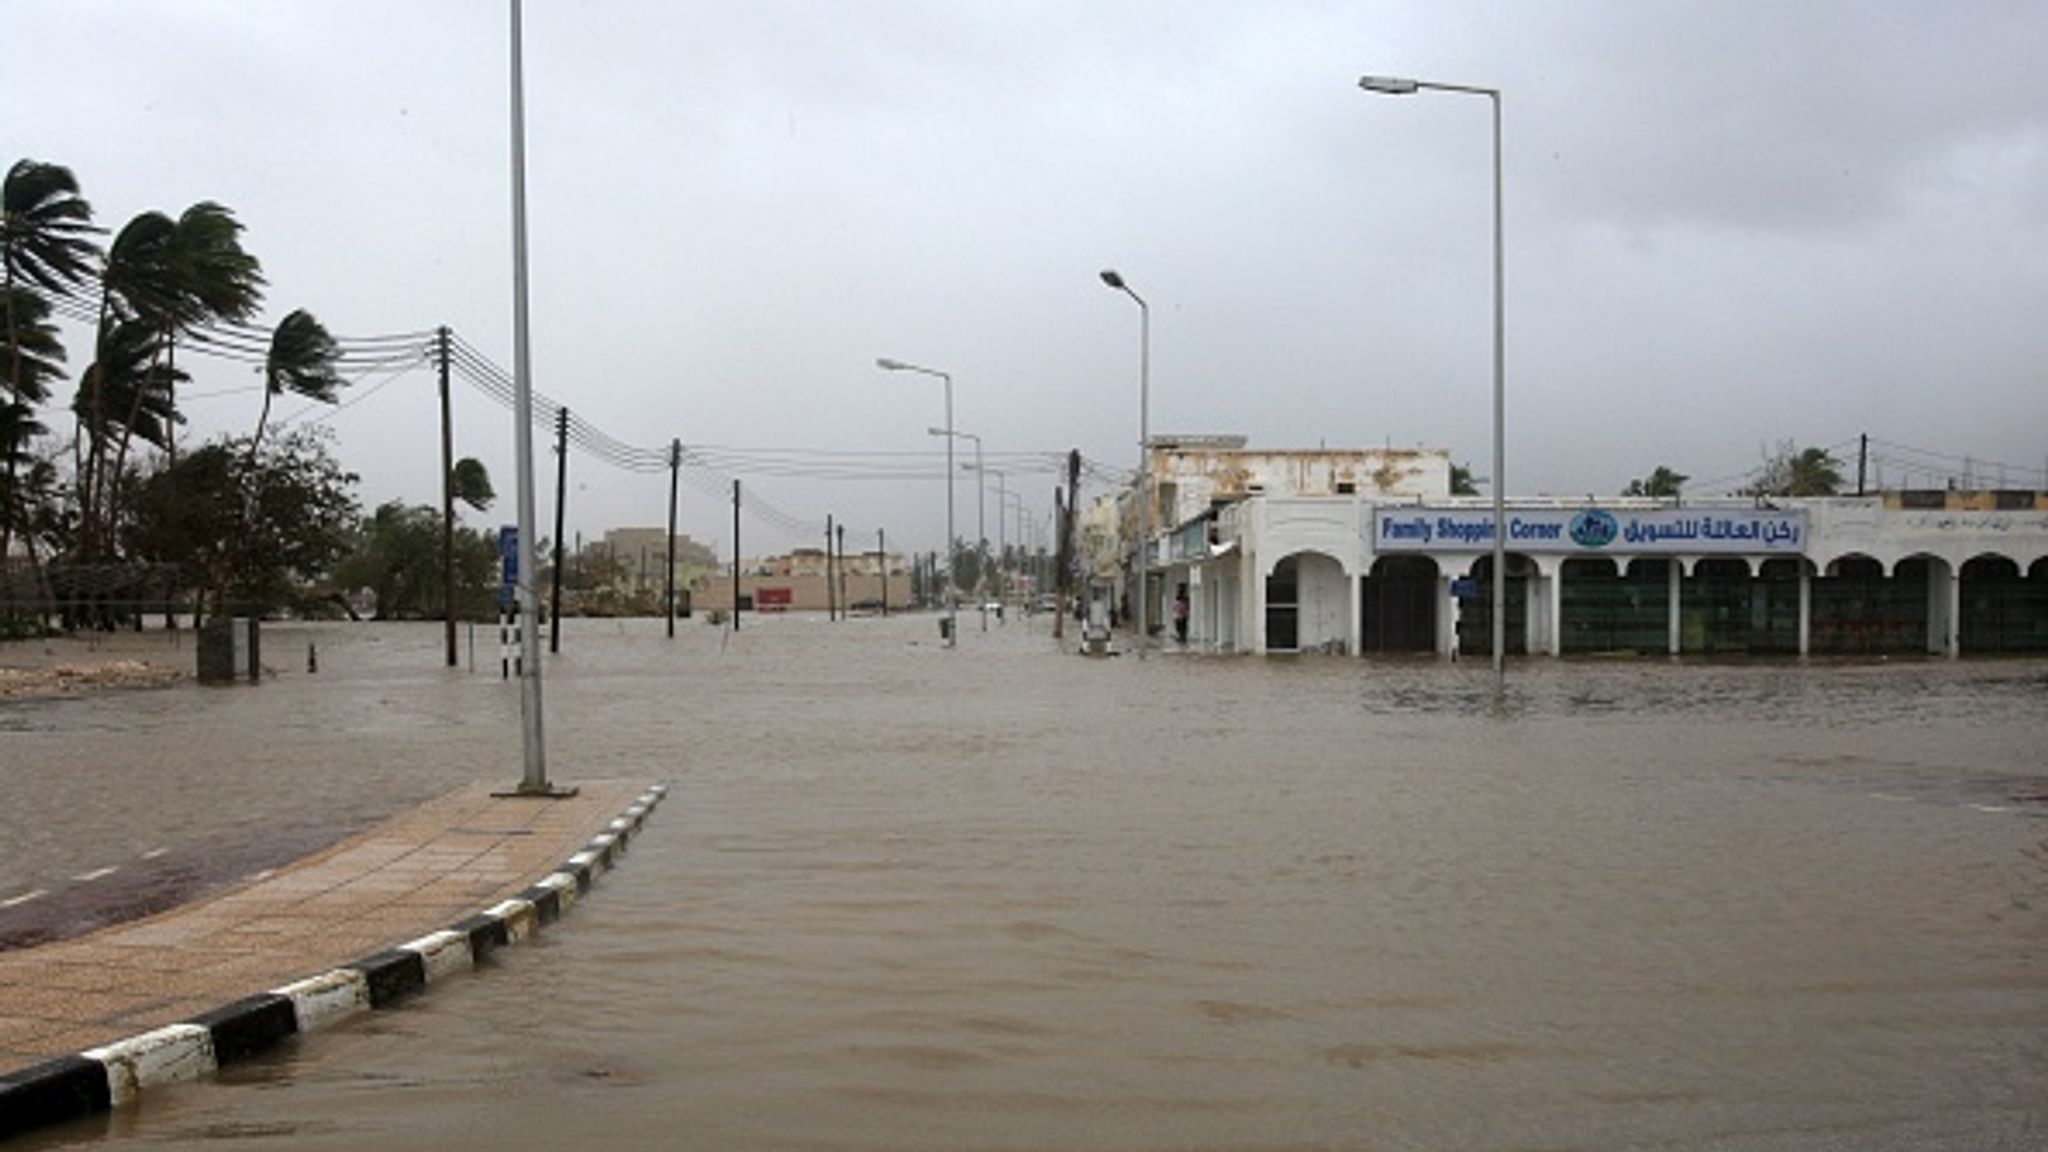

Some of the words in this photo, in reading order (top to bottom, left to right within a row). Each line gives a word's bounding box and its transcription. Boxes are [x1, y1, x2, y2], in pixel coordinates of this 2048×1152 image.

[1382, 517, 1433, 543] Family
[1510, 517, 1563, 539] Corner
[1624, 518, 1697, 543] للتسويق
[1700, 517, 1758, 539] العائلة
[1762, 519, 1799, 544] ركن
